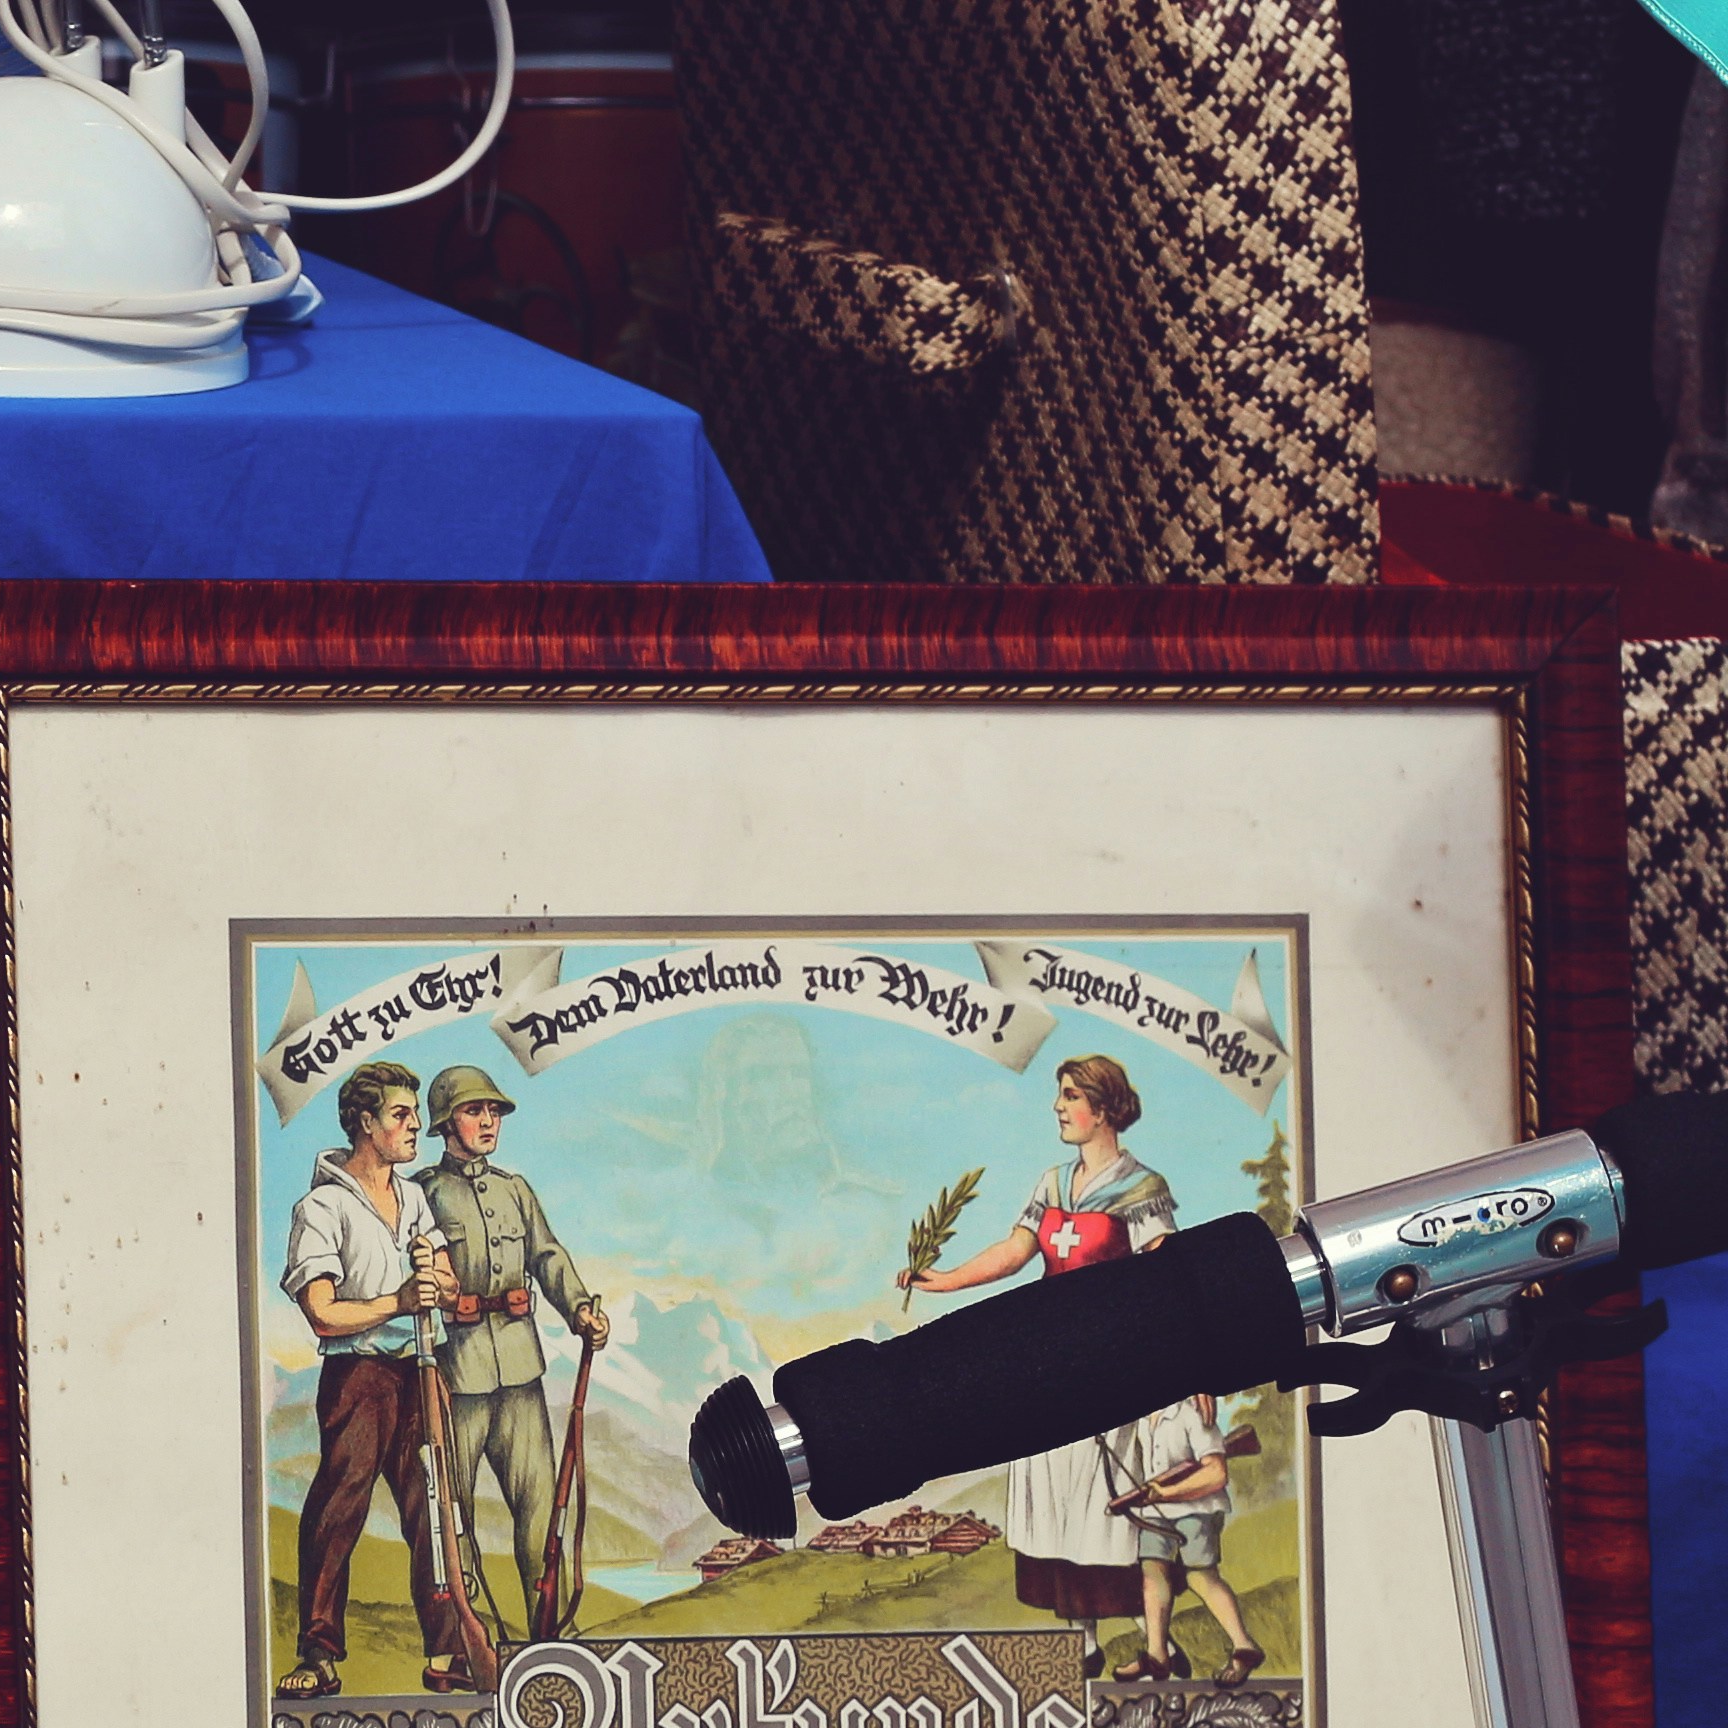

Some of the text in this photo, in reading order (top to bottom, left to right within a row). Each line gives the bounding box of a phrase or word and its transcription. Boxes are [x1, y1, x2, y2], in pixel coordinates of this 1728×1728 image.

[281, 1007, 367, 1083] Gott
[367, 994, 413, 1041] zu
[506, 994, 608, 1060] Dem
[588, 945, 782, 1013] Vaterland
[802, 964, 865, 1001] zur
[1023, 948, 1277, 1087] Jugend zur Lehr!
